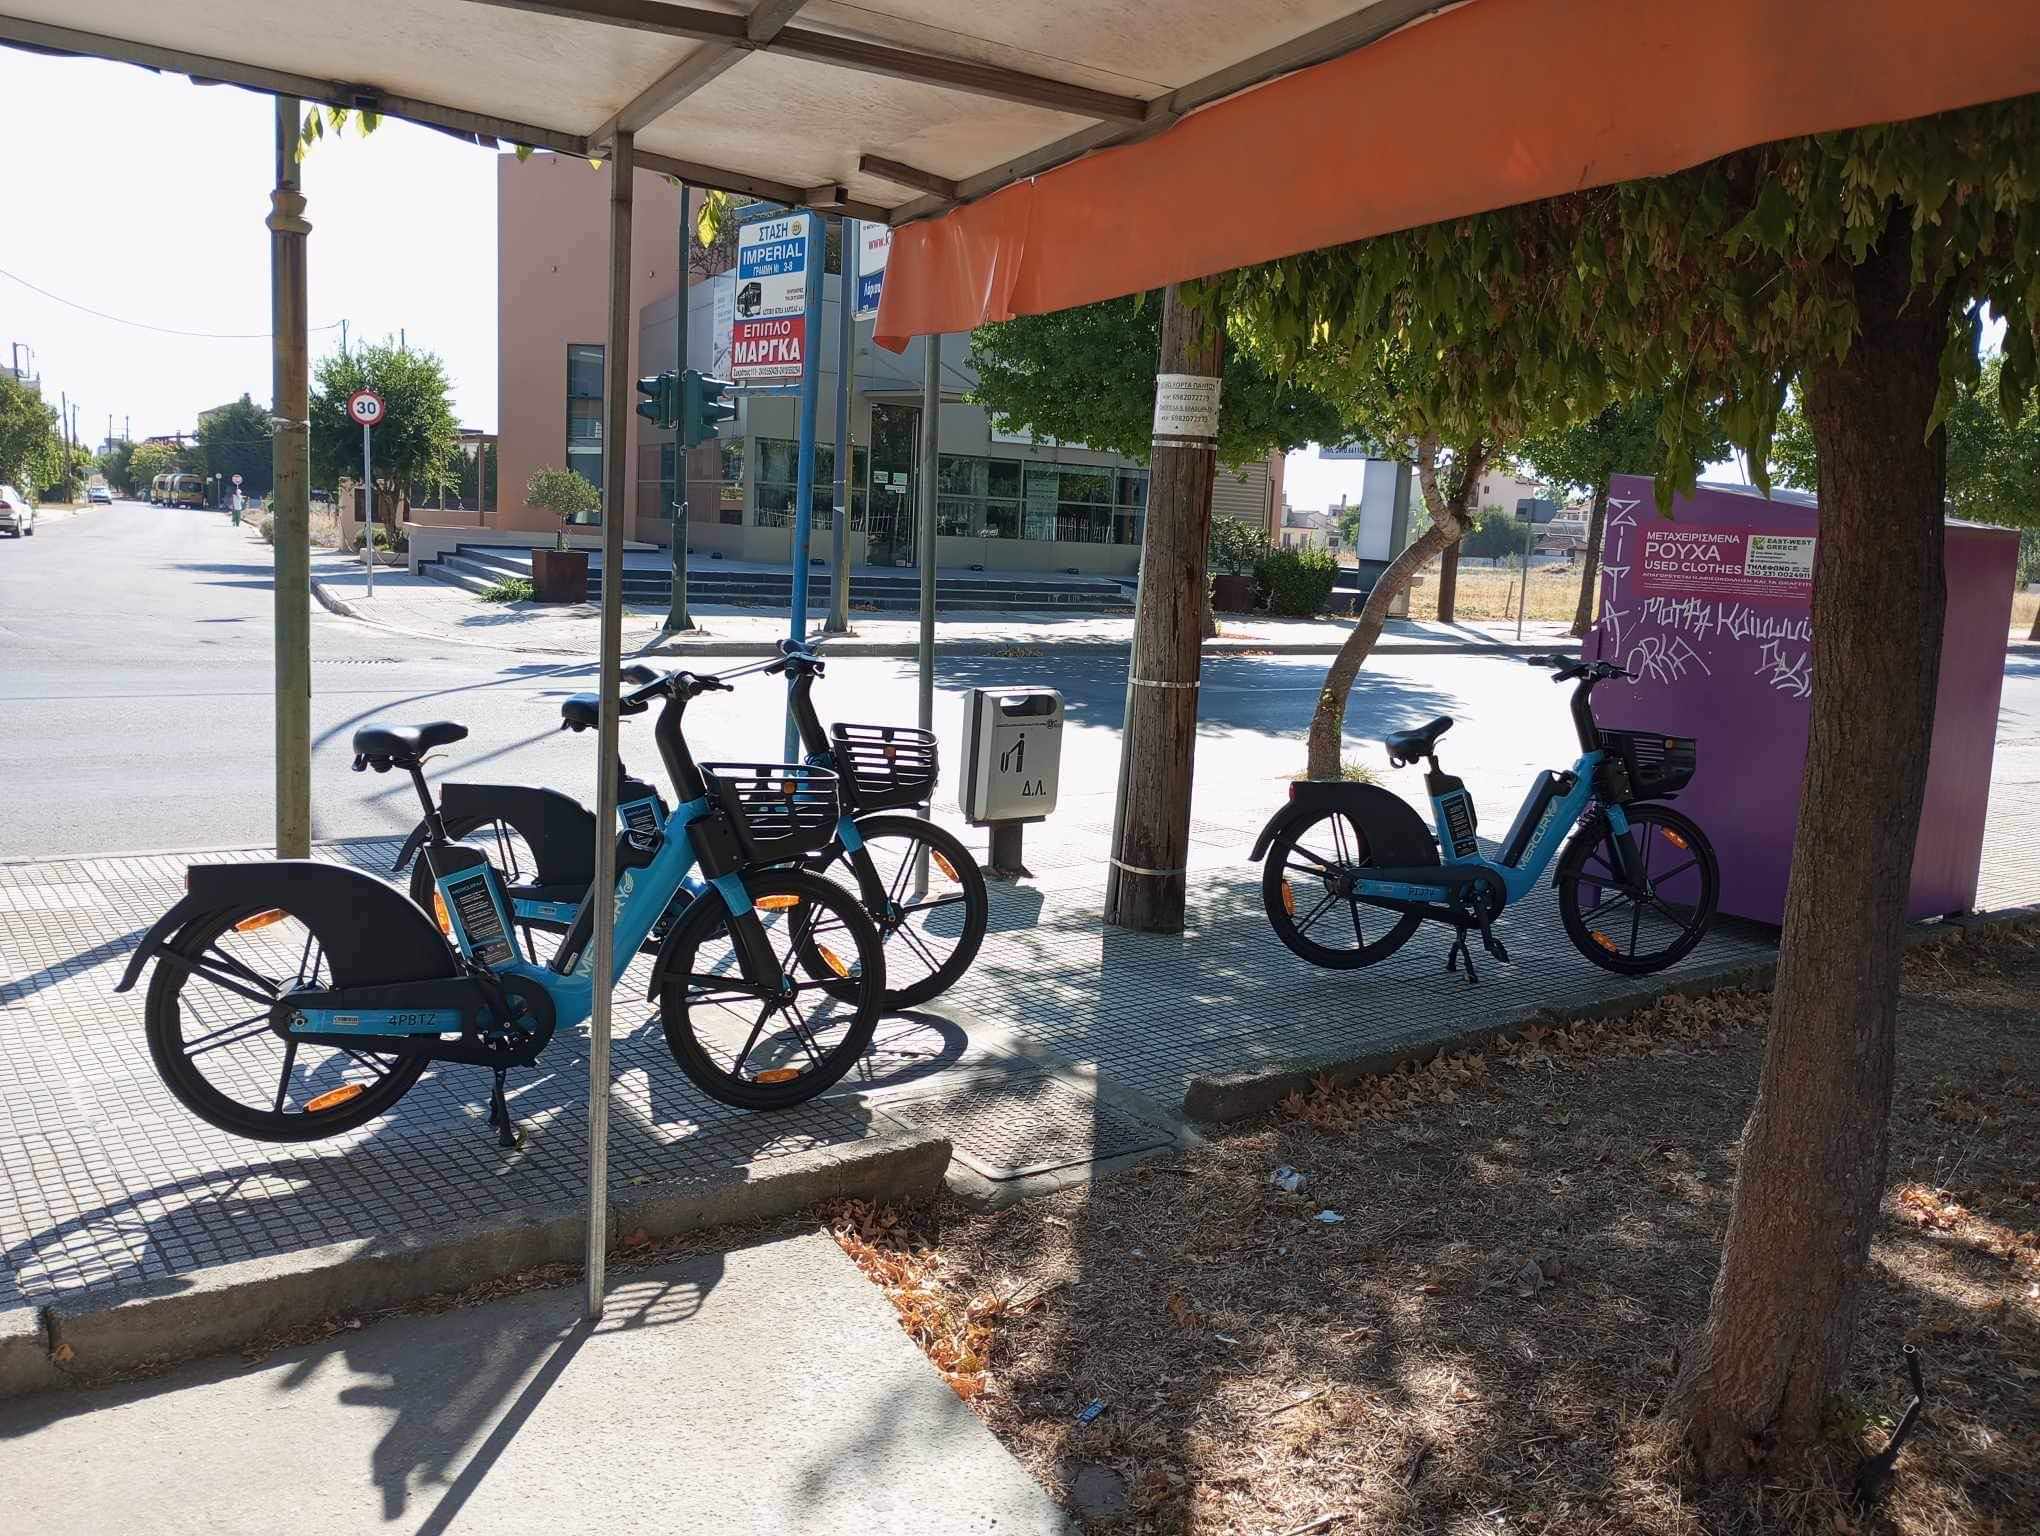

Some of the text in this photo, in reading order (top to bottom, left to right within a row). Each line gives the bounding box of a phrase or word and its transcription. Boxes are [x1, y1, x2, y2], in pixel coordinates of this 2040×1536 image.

[759, 222, 788, 241] ΣΤΑΣΗ
[743, 242, 803, 265] IMPERIAL
[744, 320, 791, 338] ΕΠΙΠΛΟ
[734, 337, 801, 364] ΜΑΡΓΚΑ
[356, 401, 376, 415] 30
[1647, 531, 1740, 544] ΜΕΤΑΧΕΙΡΙΣΜΕΝΑ
[1767, 538, 1813, 546] EAST-WEST
[1645, 542, 1721, 561] ΡΟΥΧΑ
[1644, 560, 1742, 575] USED CLOTHES
[1747, 564, 1790, 572] ΤΗΛΕΦΩΝΟ
[1516, 807, 1555, 871] MERCURY
[388, 1013, 436, 1027] 4PBTZ
